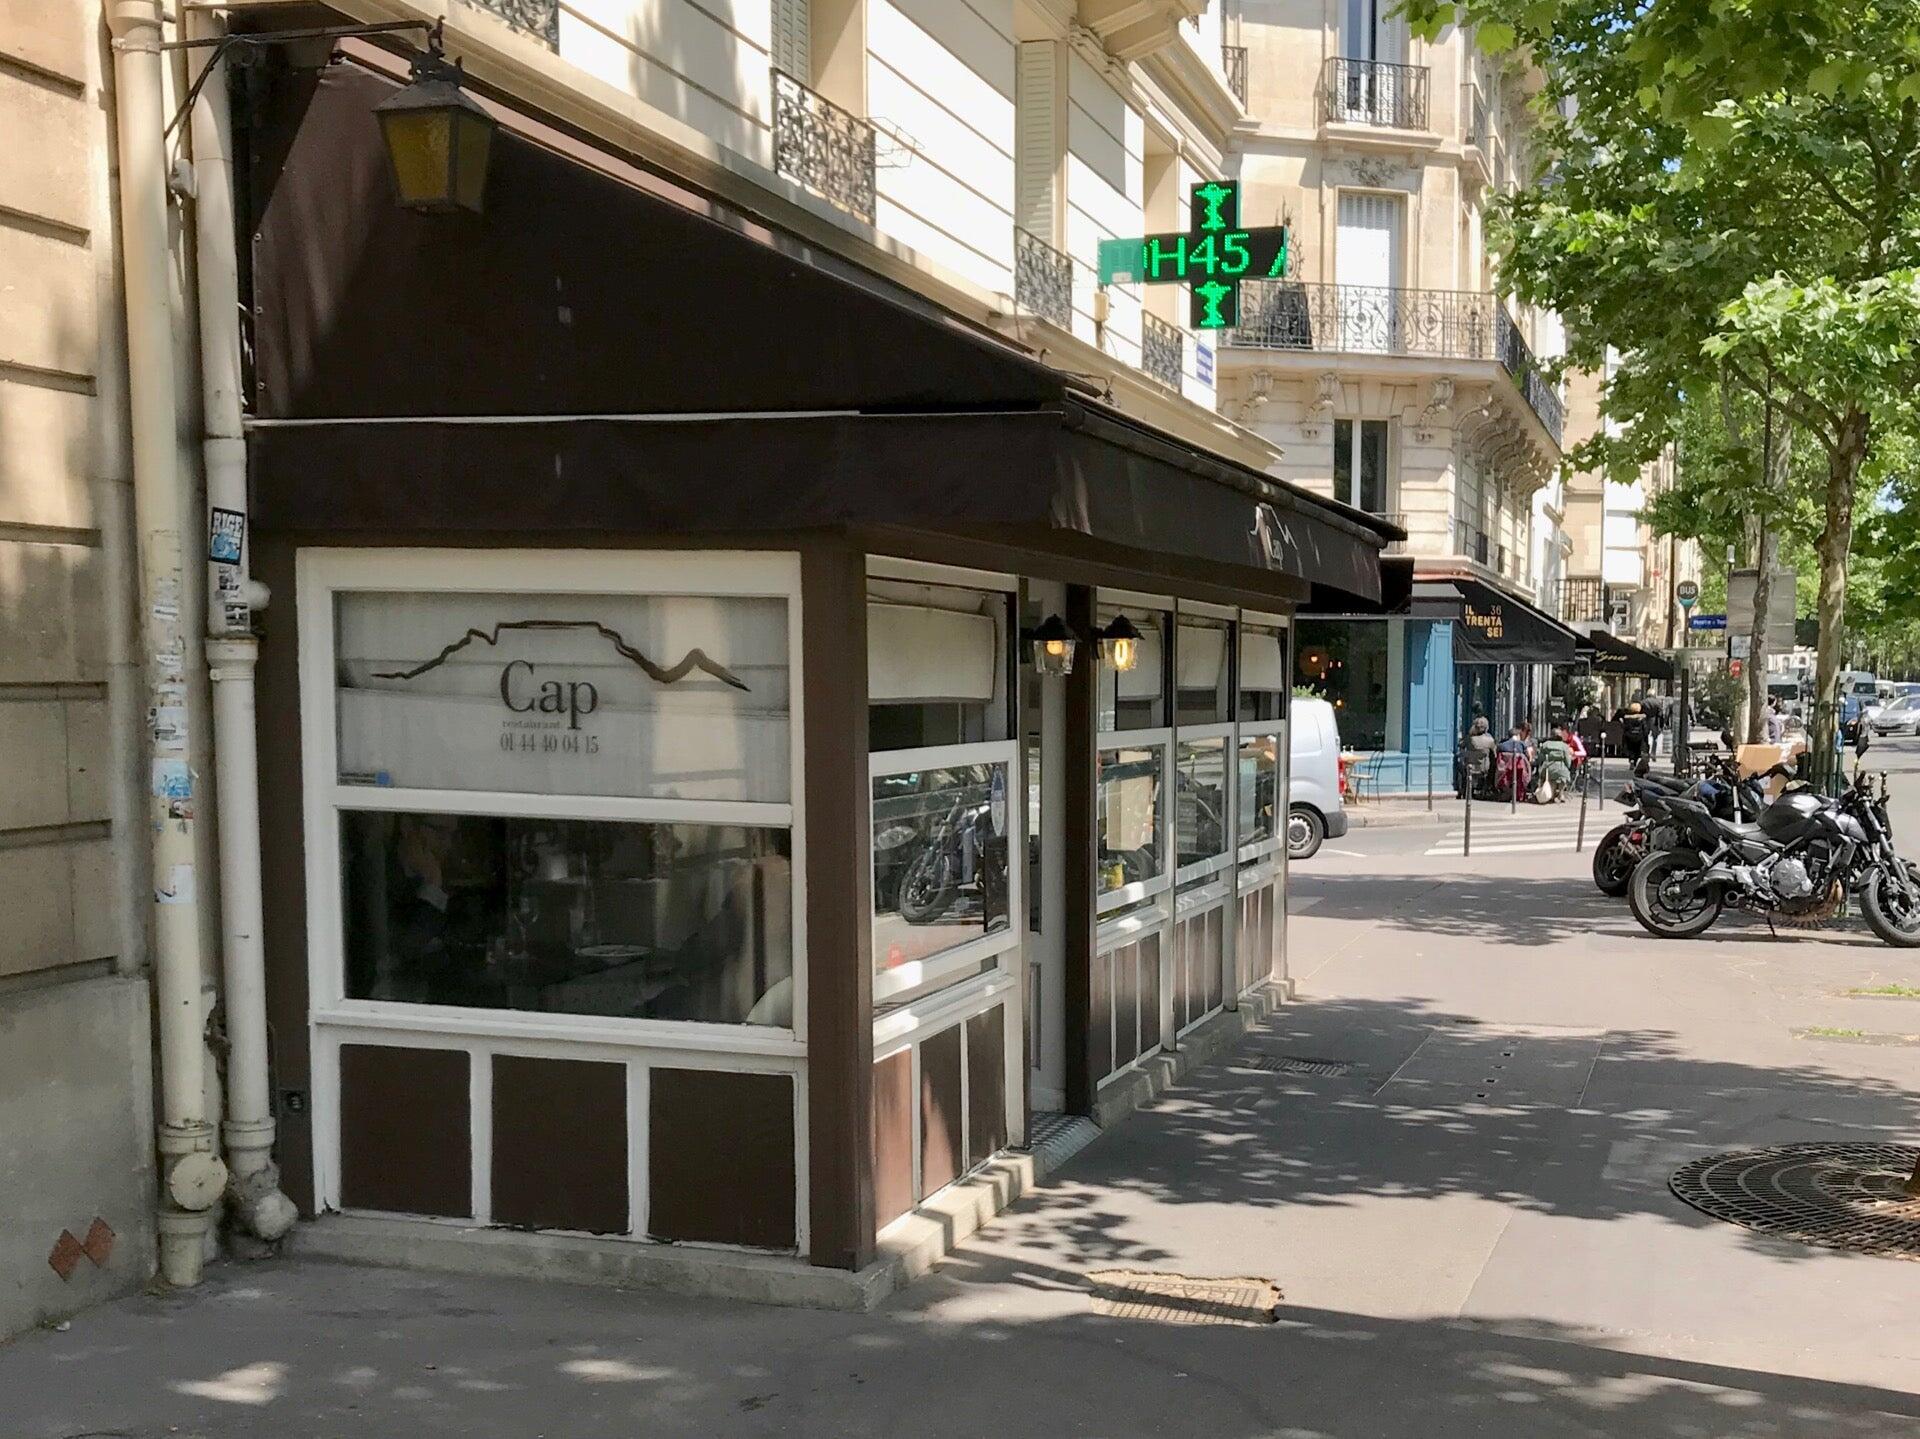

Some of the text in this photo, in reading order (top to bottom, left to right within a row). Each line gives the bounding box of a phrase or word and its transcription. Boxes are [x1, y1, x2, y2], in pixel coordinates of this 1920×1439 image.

[1143, 233, 1250, 278] H45
[1680, 585, 1696, 594] BUS
[1465, 604, 1474, 615] IL
[1465, 615, 1503, 626] TRENTA
[1486, 627, 1503, 638] SEI
[500, 659, 598, 730] Cap
[500, 732, 513, 751] 01
[586, 735, 599, 753] 15
